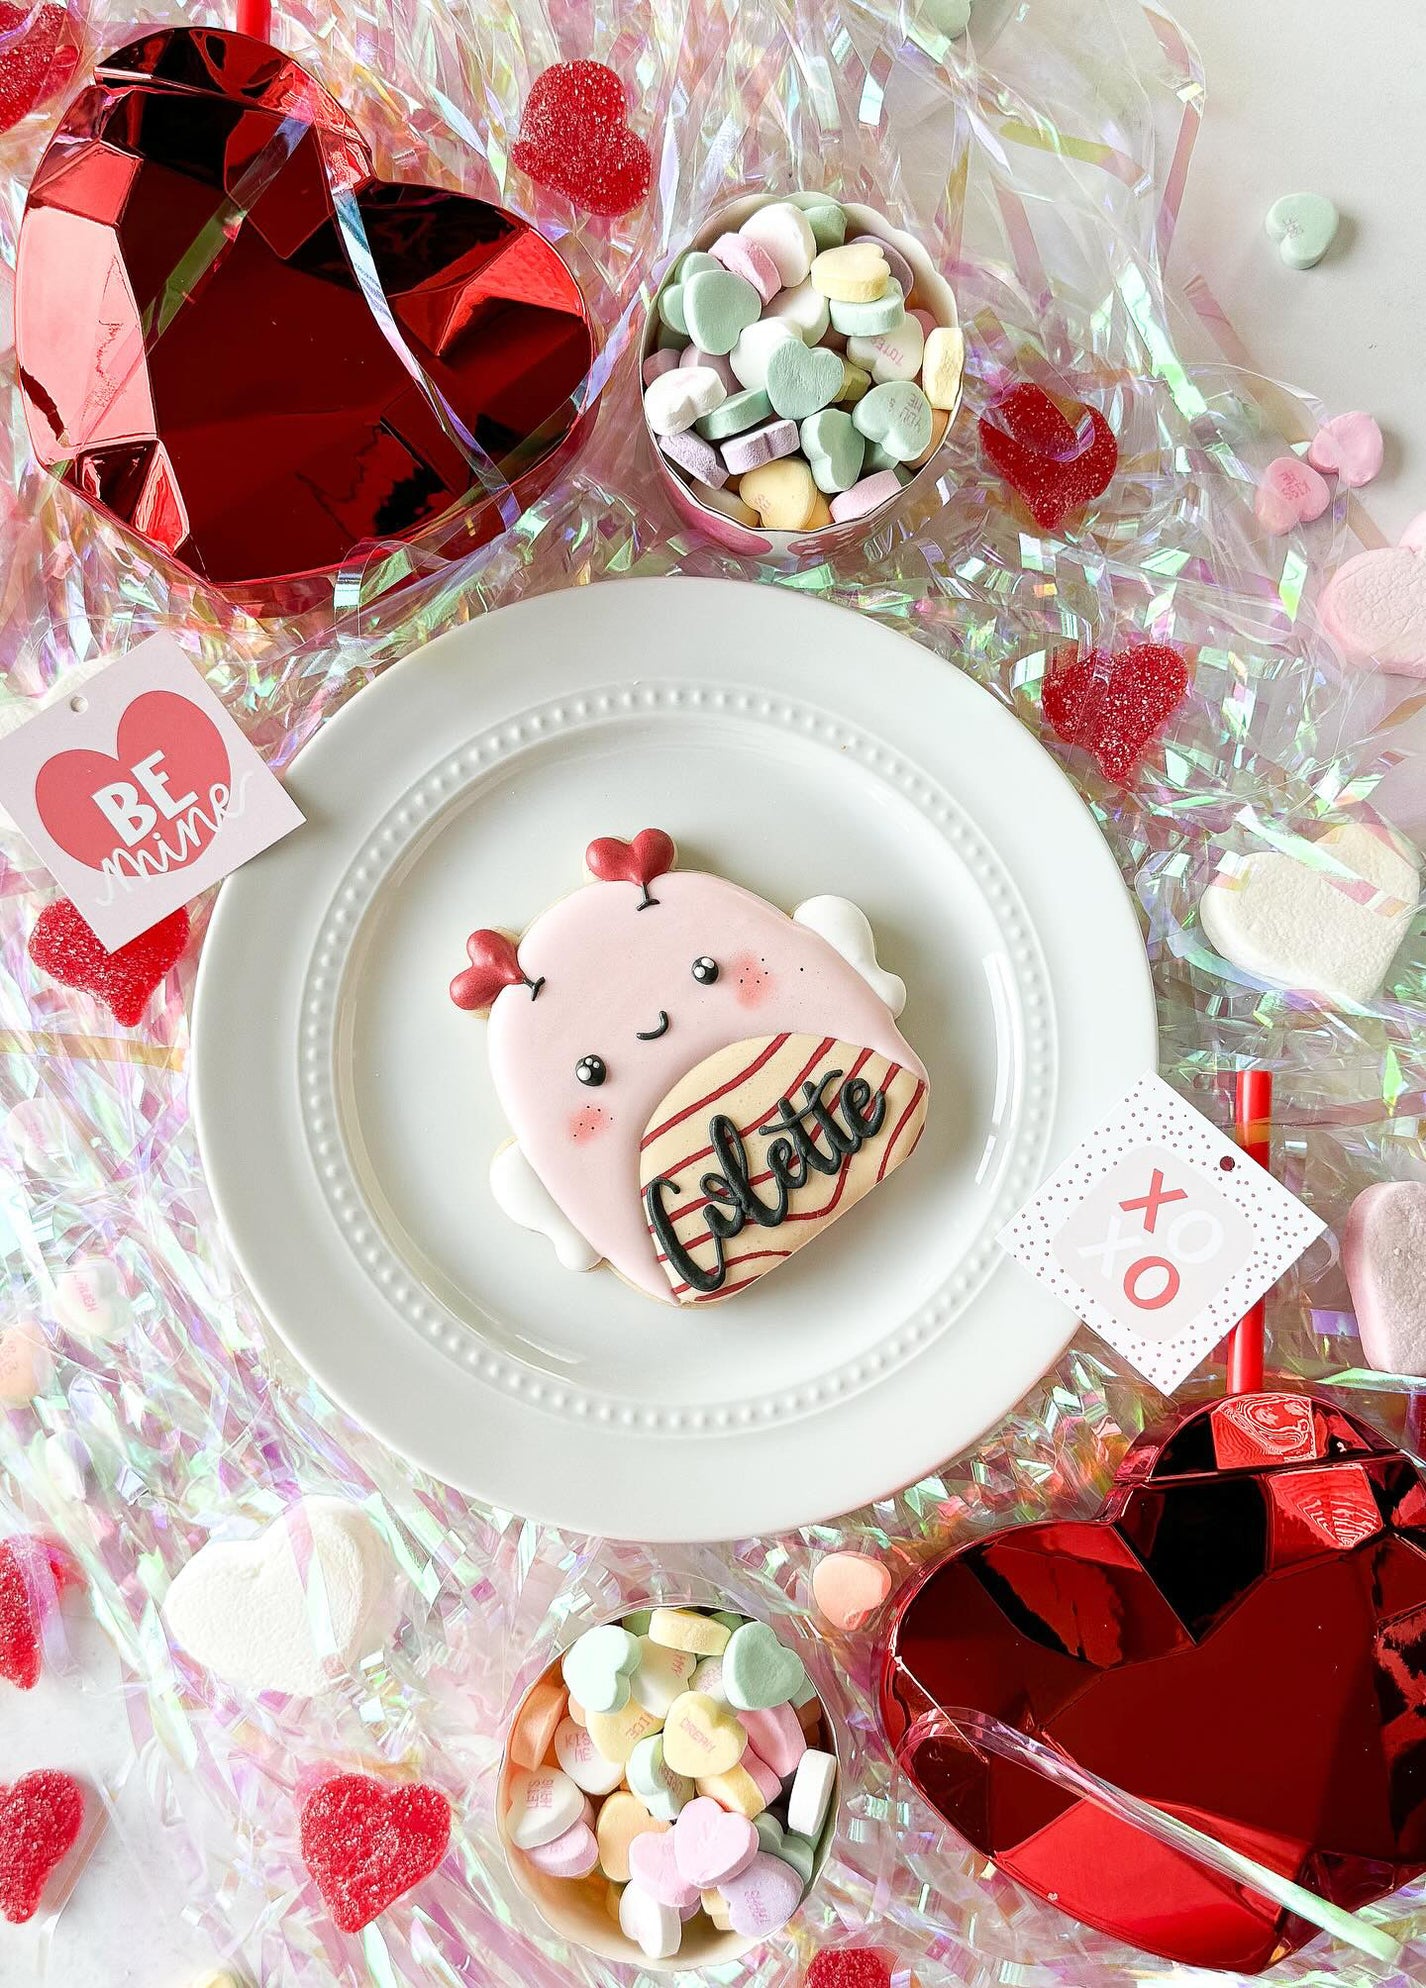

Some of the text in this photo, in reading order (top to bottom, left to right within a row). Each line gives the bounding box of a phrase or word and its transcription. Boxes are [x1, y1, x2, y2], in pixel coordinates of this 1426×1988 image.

[90, 749, 199, 848] BE
[97, 771, 254, 906] mine
[646, 1068, 887, 1292] Colette
